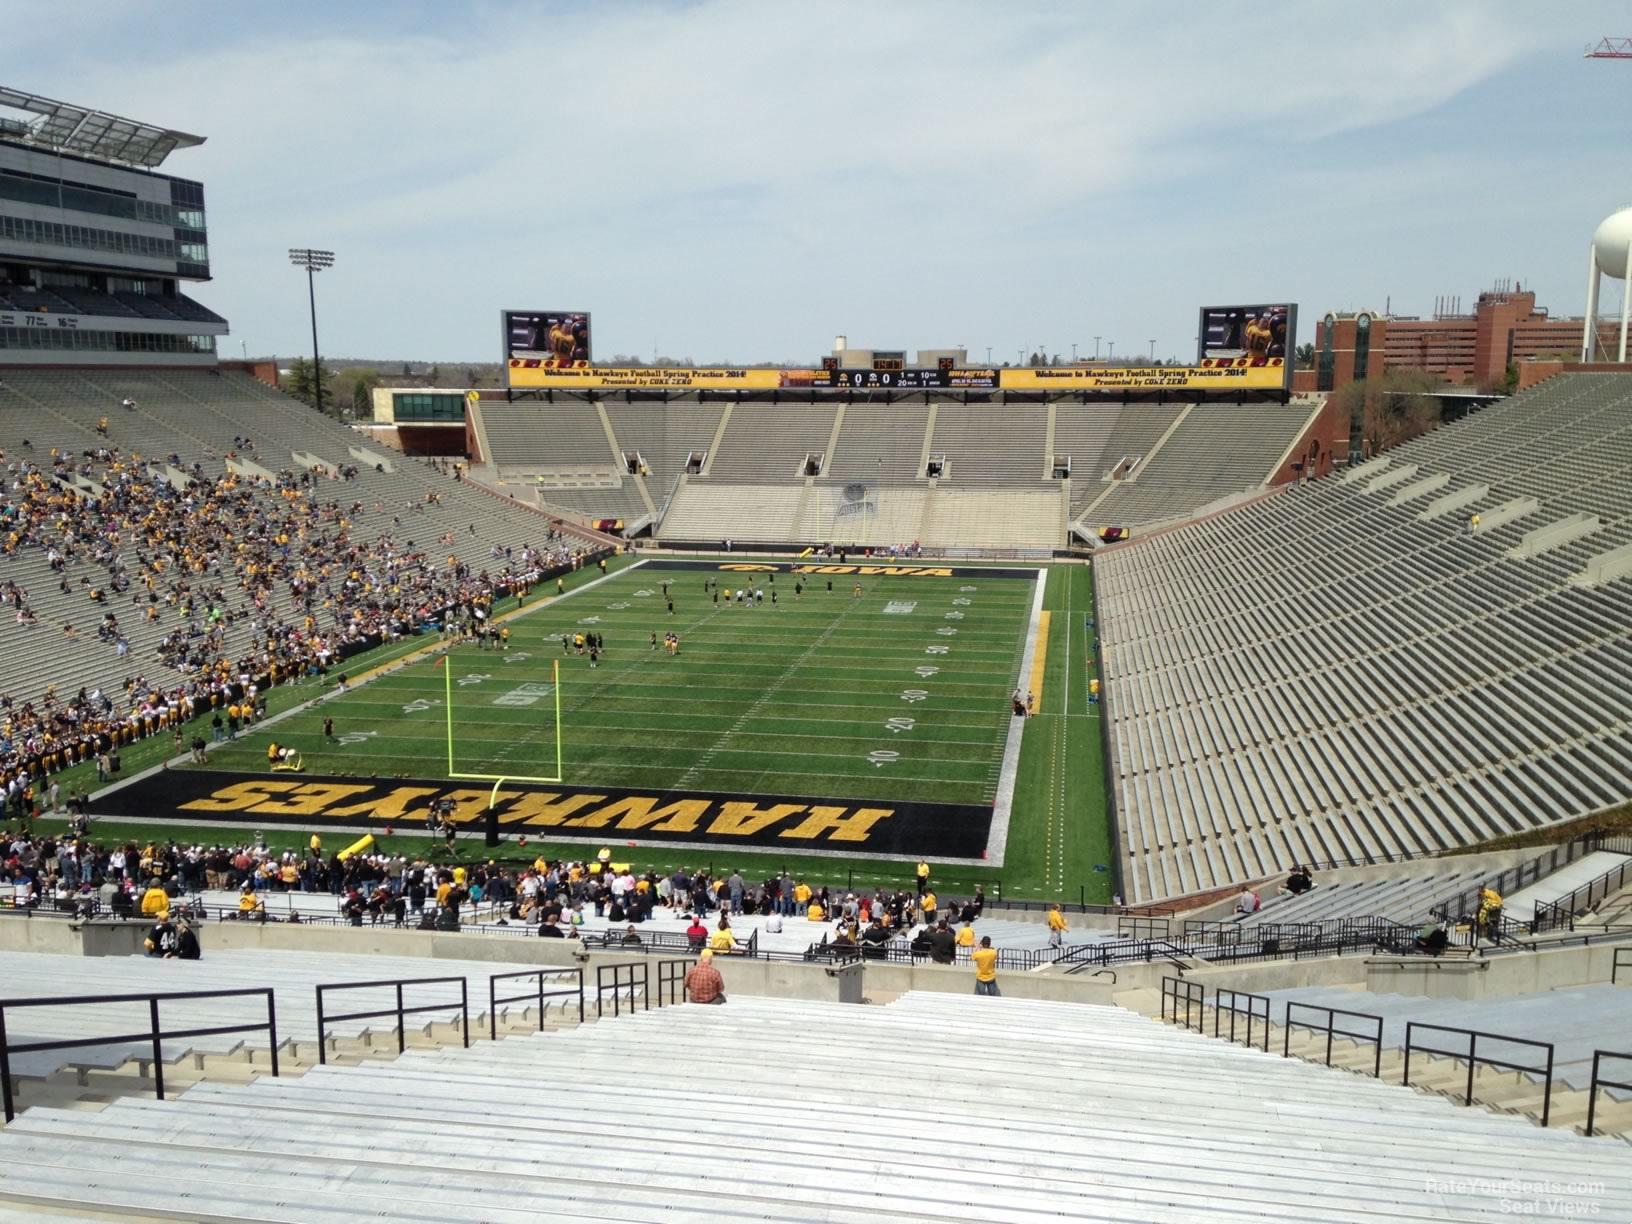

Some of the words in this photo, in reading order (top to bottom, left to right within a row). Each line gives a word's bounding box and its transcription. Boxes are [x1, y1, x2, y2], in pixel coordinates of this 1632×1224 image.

[25, 316, 36, 326] 77
[58, 318, 67, 327] 16
[824, 358, 836, 369] 25
[940, 358, 953, 368] 25
[592, 370, 628, 378] Hawkeye
[664, 370, 690, 379] Spring
[855, 374, 862, 383] 0
[882, 374, 890, 383] 0
[1159, 370, 1186, 378] Spring
[795, 564, 953, 577] IOWA
[866, 750, 900, 762] 10
[177, 779, 894, 842] HAWKEYES
